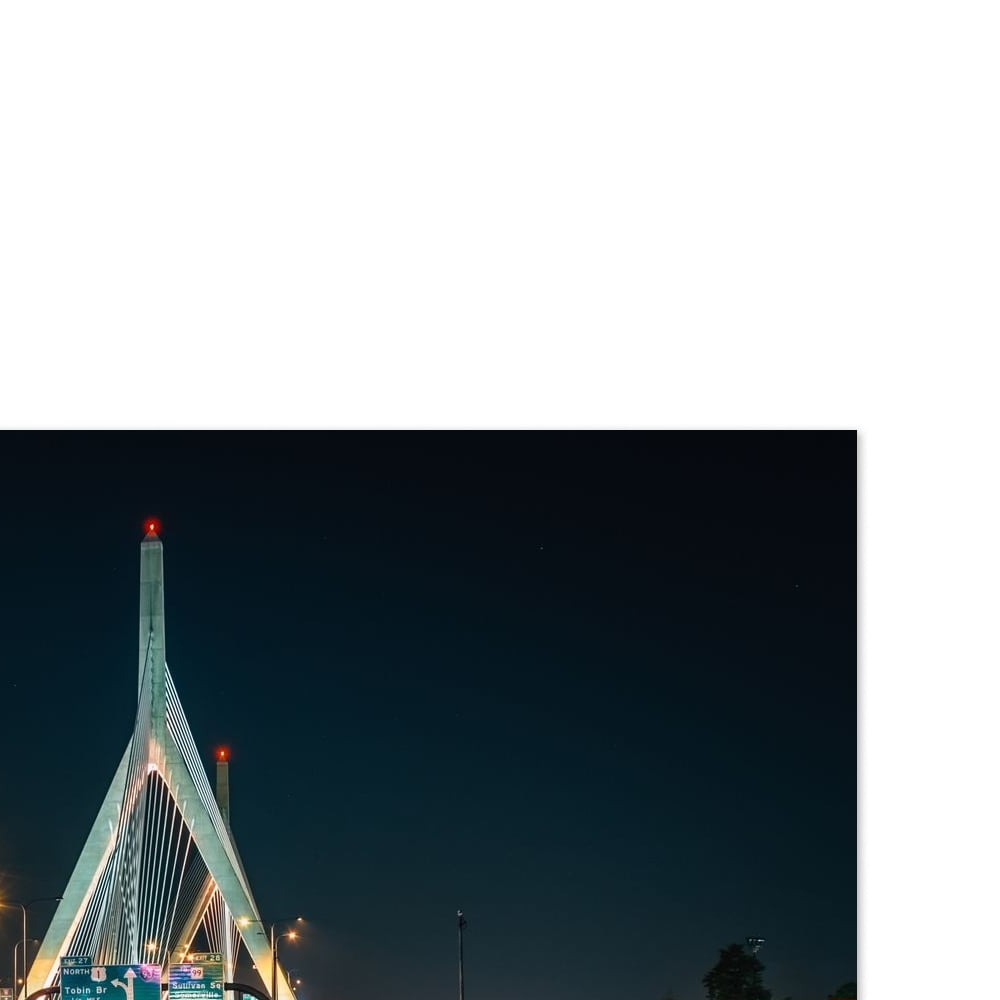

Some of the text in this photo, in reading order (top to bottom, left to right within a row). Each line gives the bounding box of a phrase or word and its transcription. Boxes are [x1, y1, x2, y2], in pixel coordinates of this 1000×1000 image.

[191, 969, 202, 977] 99
[65, 986, 108, 994] Tobin Br
[210, 982, 221, 990] Sq
